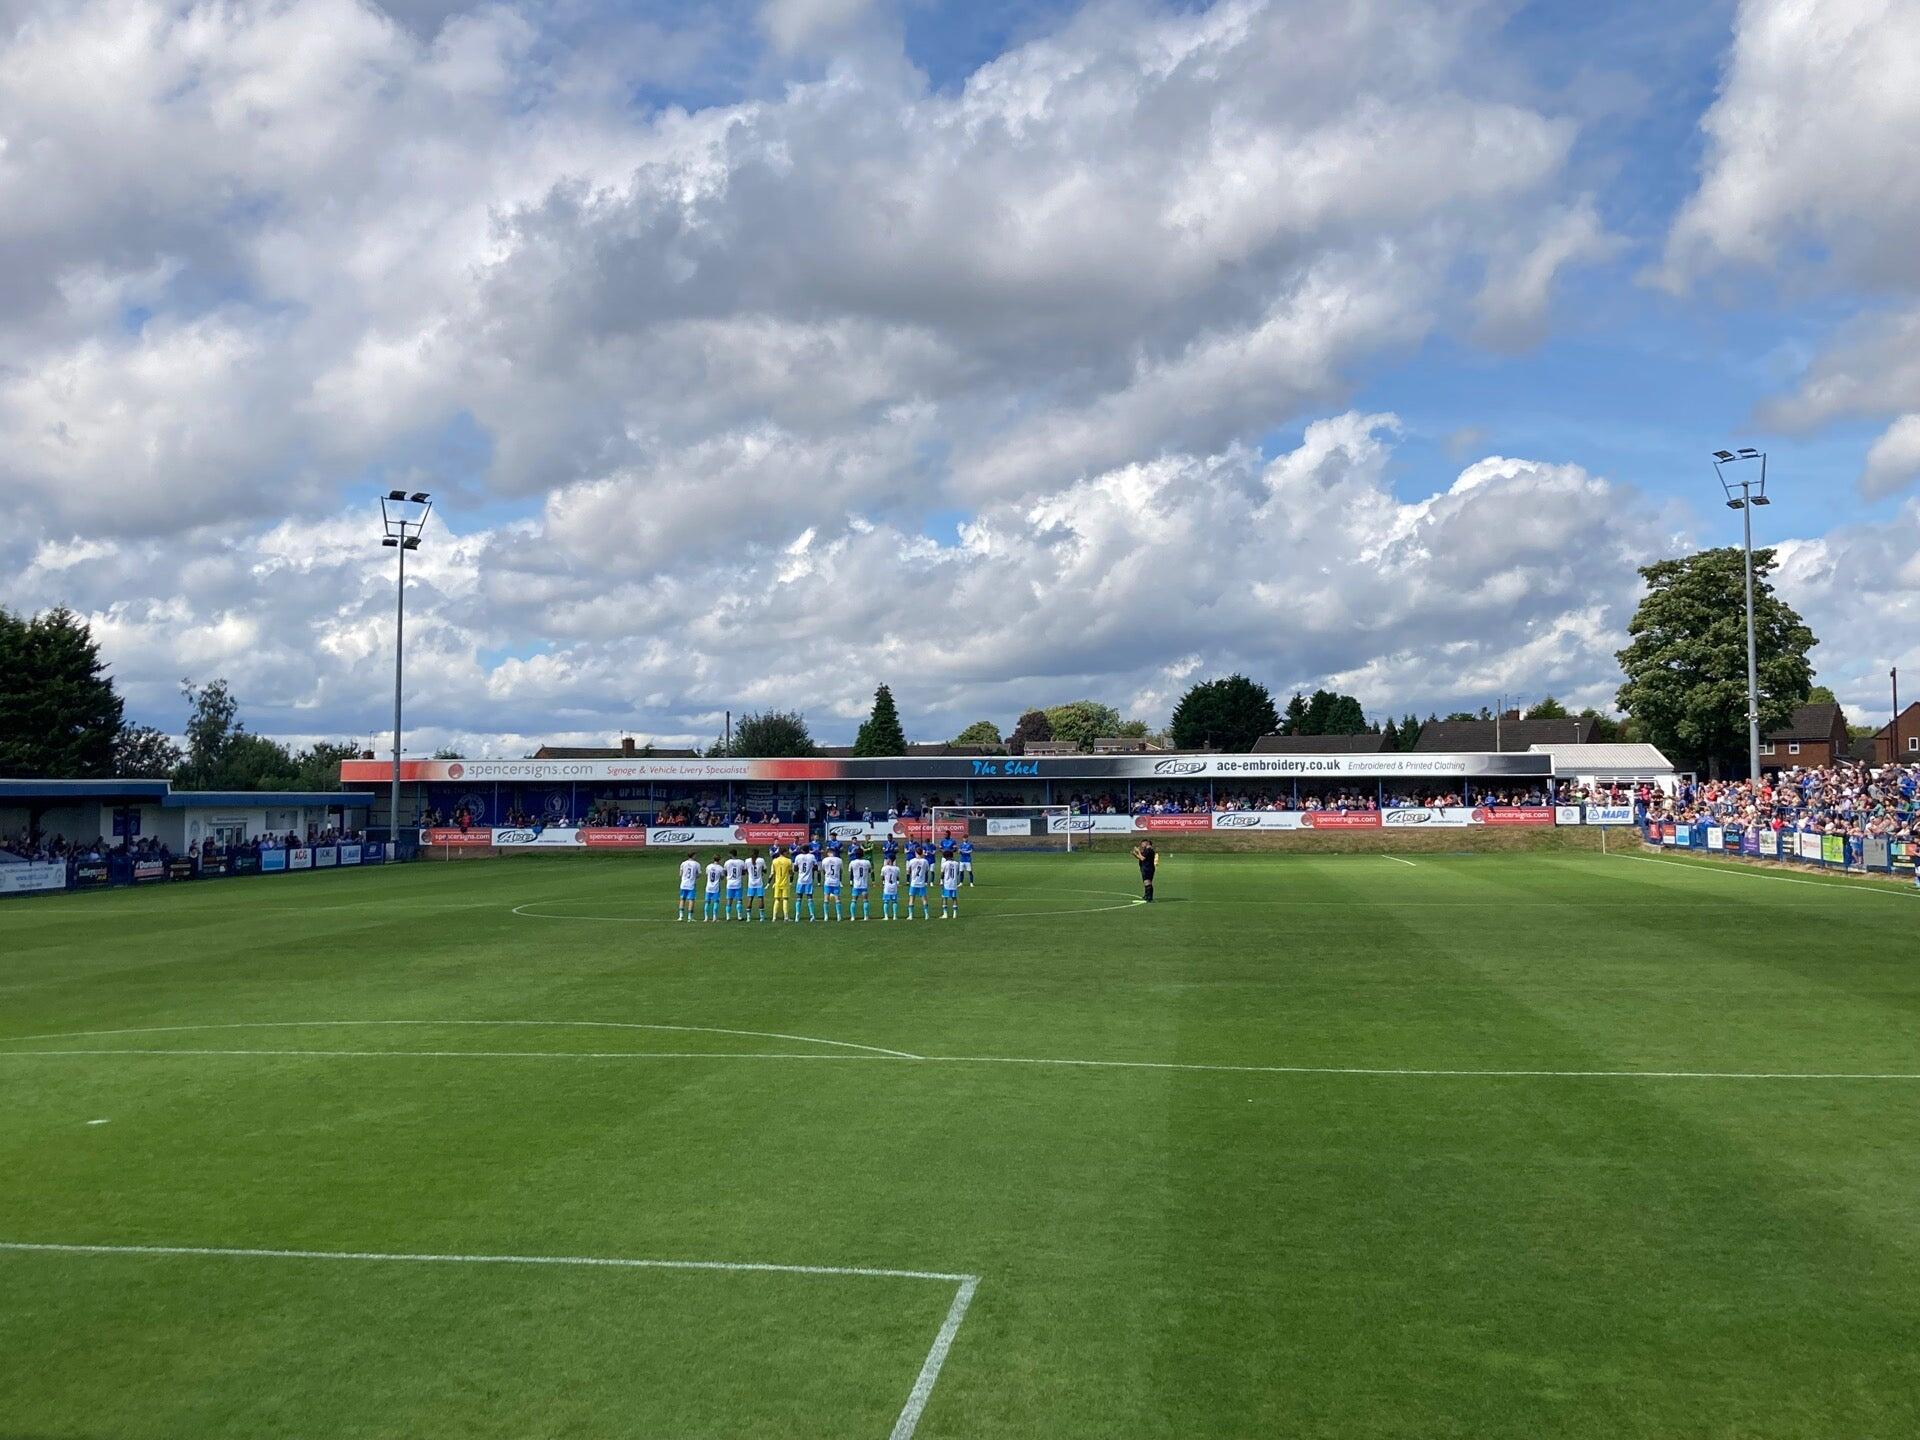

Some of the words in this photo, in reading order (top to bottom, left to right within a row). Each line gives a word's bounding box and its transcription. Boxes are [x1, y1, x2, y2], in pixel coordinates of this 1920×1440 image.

[607, 766, 637, 776] Signage
[639, 766, 647, 774] &
[650, 766, 677, 774] Vehicle
[679, 766, 703, 776] Livery
[972, 761, 997, 775] The
[1004, 761, 1039, 775] Shed
[1217, 760, 1340, 773] ace-embroidery.co.uk
[1348, 761, 1396, 771] Embroidered
[1397, 761, 1404, 770] &
[1405, 761, 1432, 770] Printed
[1434, 760, 1465, 772] Clothing
[469, 764, 593, 779] spencersigns.com
[1601, 810, 1630, 819] MAPEI
[1150, 818, 1209, 826] spencersigns.com
[589, 833, 645, 841] spencersigns.com
[749, 830, 804, 838] spencersigns.com
